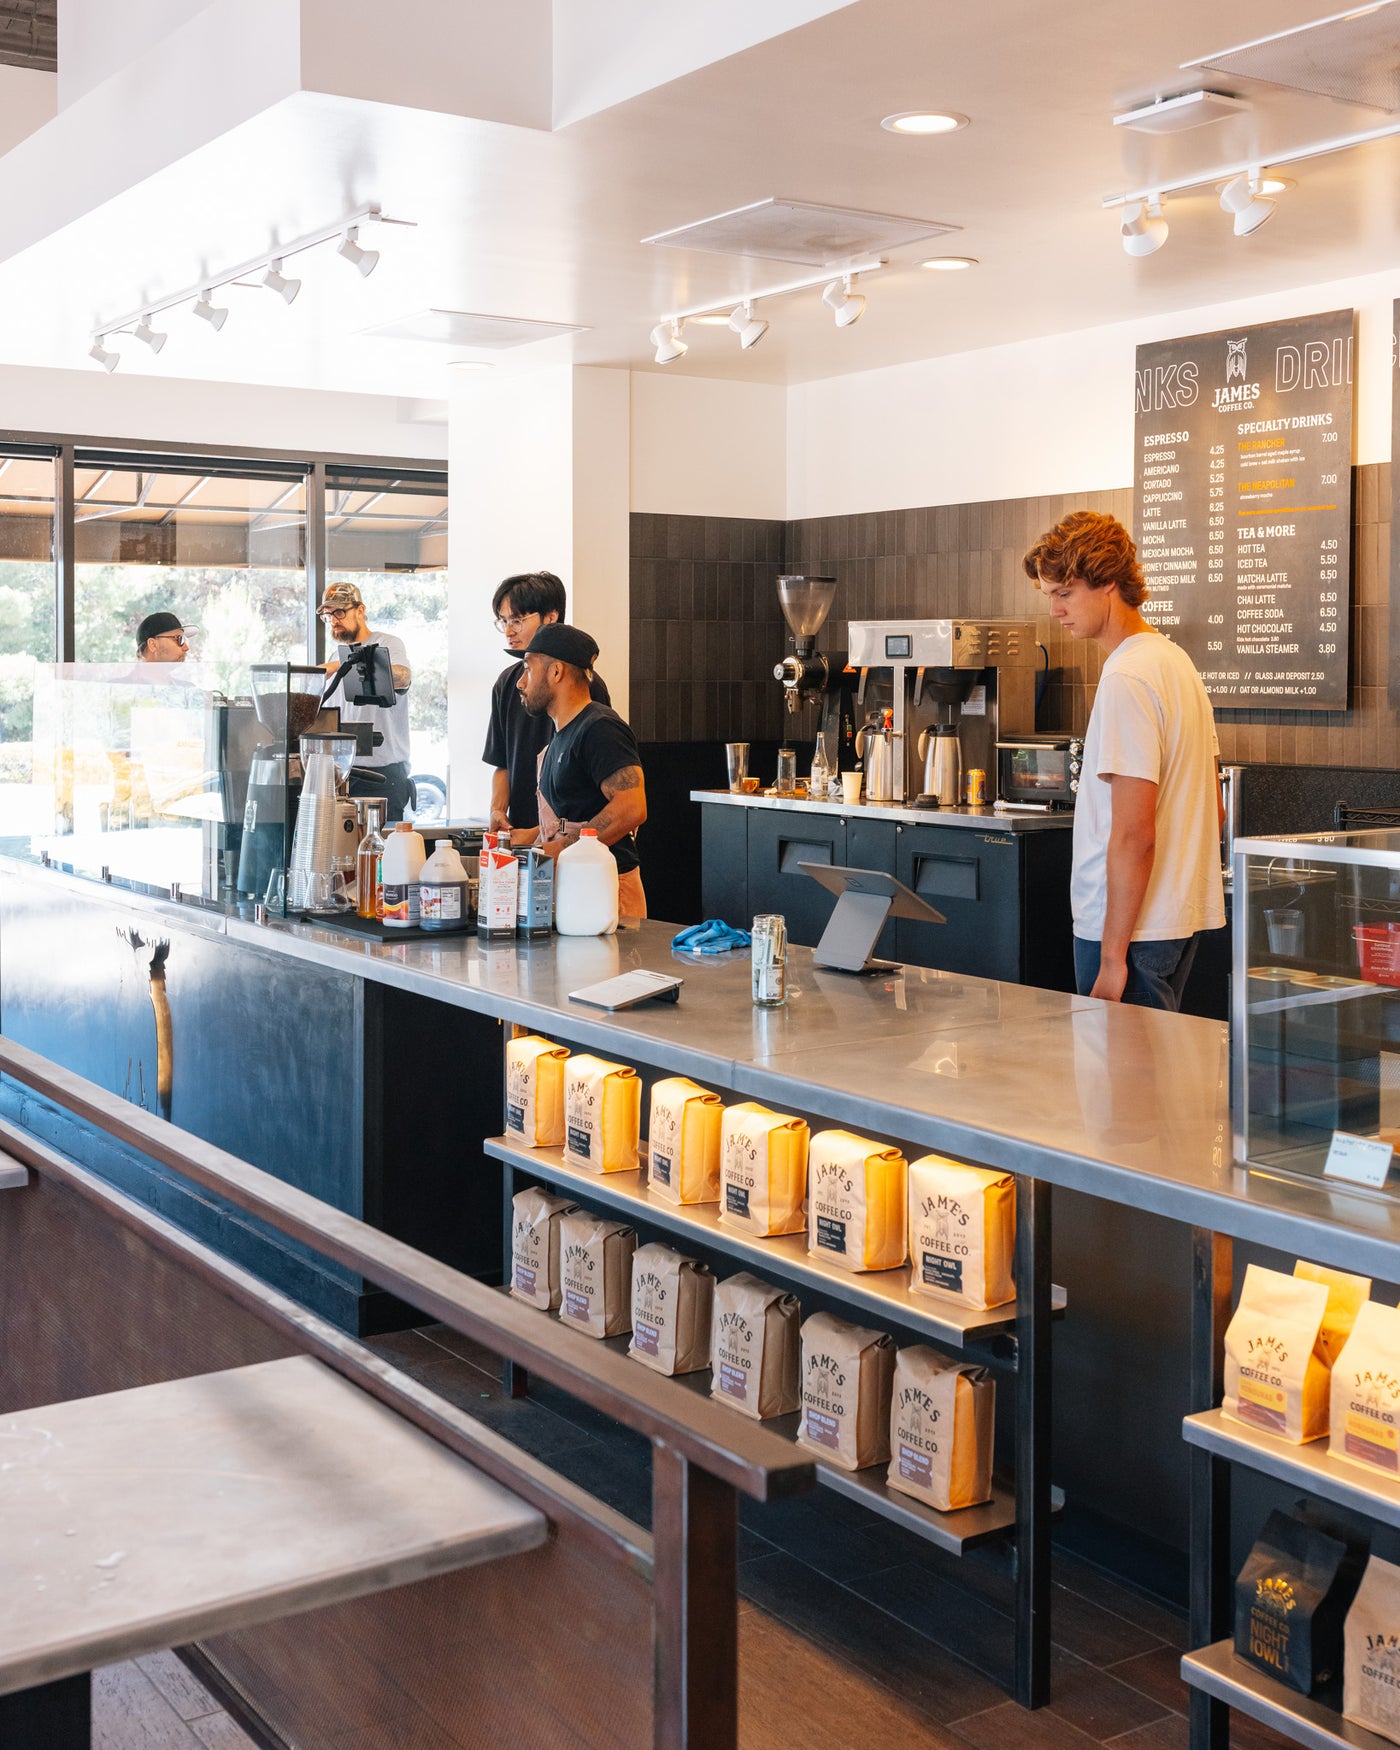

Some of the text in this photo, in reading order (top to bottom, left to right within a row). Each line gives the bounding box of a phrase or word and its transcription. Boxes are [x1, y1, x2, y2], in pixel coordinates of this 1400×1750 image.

[1211, 383, 1260, 408] JAMES
[1218, 401, 1255, 413] COFFEE CO.
[1237, 413, 1333, 435] SPECIALTY DRINKS
[1144, 431, 1189, 446] ESPRESSO
[1237, 432, 1338, 451] THE RANCHER 7.00
[1143, 445, 1225, 463] ESPRESSO 4.25
[1143, 459, 1225, 476] AMERICANO 4.25
[1143, 473, 1225, 490] CORTADO 5.25
[1237, 474, 1337, 491] THE NEAPOLITAN 7.00
[1143, 487, 1224, 503] CAPPUCCINO 5.75
[1143, 502, 1224, 517] LATTE 6.25
[1142, 516, 1225, 531] VANILLA LATTE 6.50
[1237, 524, 1296, 539] TEA & MORE
[1142, 531, 1224, 545] MOCHA 6.50
[1237, 539, 1338, 554] HOT TEA 4.50
[1142, 544, 1224, 558] MEXICAN MOCHA 6.50
[1142, 559, 1224, 572] HONEY CINNAMON 6.50
[1237, 554, 1337, 569] ICED TEA 5.50
[1179, 574, 1196, 584] MILK
[1208, 573, 1223, 583] 6.50
[1237, 569, 1337, 583] MATCHA LATTE 6.50
[1141, 600, 1173, 612] COFFEE
[1237, 592, 1337, 605] CHAI LATTE 6.50
[1162, 615, 1180, 625] BREW
[1207, 614, 1224, 624] 4.00
[1237, 607, 1337, 619] COFFEE SODA 6.50
[1237, 622, 1337, 633] HOT CHOCOLATE 4.50
[1207, 641, 1223, 651] 5.50
[1236, 643, 1336, 654] VANILLA STEAMER 3.80
[1207, 672, 1218, 680] HOT
[1218, 672, 1226, 680] OR
[1226, 672, 1240, 680] ICED
[1255, 672, 1274, 680] GLASS
[1274, 672, 1285, 680] JAR
[1285, 672, 1310, 680] DEPOSIT
[1310, 672, 1325, 680] 2.50
[1239, 686, 1250, 694] OAT
[1250, 686, 1259, 694] OR
[1259, 686, 1284, 694] ALMOND
[726, 1132, 757, 1160] JAMES
[725, 1169, 744, 1184] COFFEE
[816, 1162, 853, 1192] JAMES
[815, 1201, 839, 1217] COFFEE
[921, 1194, 970, 1226] JAMES
[515, 1221, 541, 1246] JAMES
[818, 1218, 842, 1232] NIGHT OWL
[920, 1235, 971, 1256] COFFEE CO.
[565, 1244, 596, 1271] JAMES
[925, 1255, 957, 1270] NIGHT OWL
[565, 1277, 584, 1291] COFFEE
[636, 1272, 667, 1300] JAMES
[635, 1306, 654, 1323] COFFEE
[719, 1312, 753, 1342] JAMES
[718, 1348, 740, 1365] COFFEE
[1247, 1335, 1289, 1362] JAMES
[807, 1354, 846, 1386] JAMES
[1240, 1366, 1284, 1387] COFFEE CO.
[1354, 1371, 1400, 1399] JAMES
[803, 1391, 830, 1412] COFFEE
[899, 1387, 941, 1422] JAMES
[1350, 1401, 1380, 1419] COFFEE
[897, 1426, 923, 1448] COFFEE
[1256, 1577, 1297, 1610] JAMES
[1250, 1605, 1278, 1627] COFFEE
[1250, 1617, 1289, 1653] NIGHT
[1253, 1641, 1283, 1670] OWL
[1361, 1664, 1395, 1686] COFFEE
